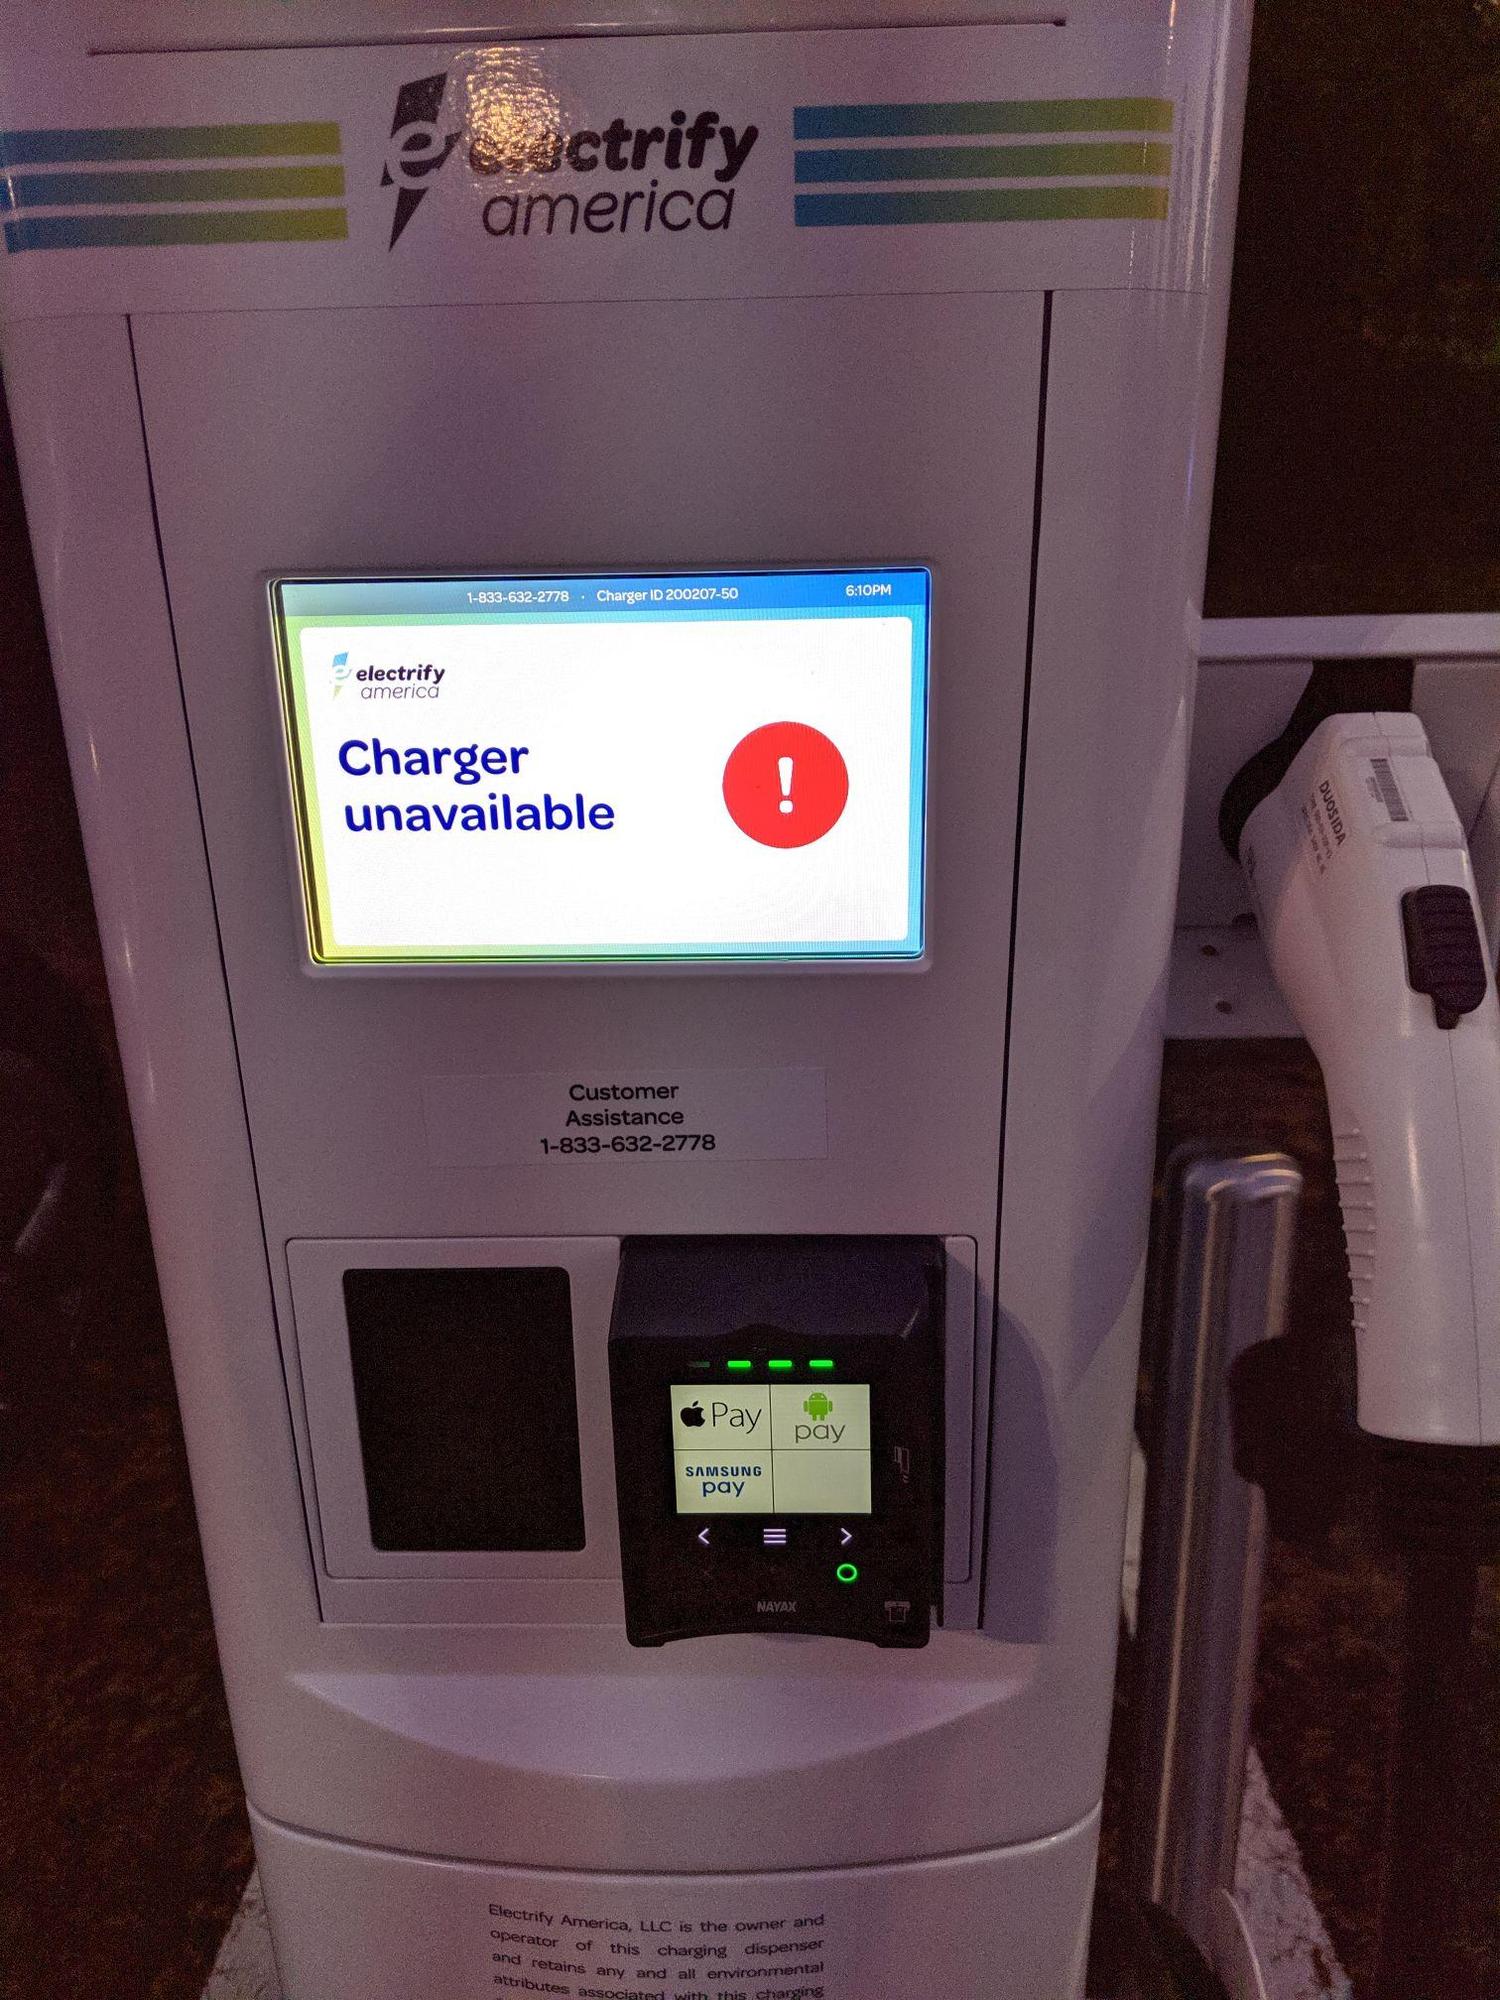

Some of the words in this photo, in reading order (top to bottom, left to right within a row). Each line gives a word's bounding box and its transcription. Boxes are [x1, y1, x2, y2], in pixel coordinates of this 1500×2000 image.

[469, 110, 759, 183] eectrify
[482, 179, 736, 237] america
[467, 590, 570, 605] 1-833-632-2778
[596, 588, 648, 605] Charger
[650, 589, 664, 602] ID
[665, 587, 739, 601] 200207-50
[845, 584, 892, 597] 6:10PM
[356, 664, 445, 684] electrify
[360, 683, 440, 700] america
[338, 737, 530, 786] Charger
[344, 792, 615, 832] unavailable
[1319, 780, 1346, 845] DUOSIDA
[569, 1084, 679, 1101] Customer
[565, 1109, 684, 1127] Assistance
[540, 1134, 716, 1154] 1-833-632-2778
[711, 1401, 763, 1435] Pay
[795, 1423, 846, 1443] pay
[685, 1465, 762, 1477] SAMSUNG
[702, 1479, 745, 1498] pay
[757, 1601, 797, 1613] NAYAX
[488, 1903, 553, 1927] Electrify
[561, 1914, 632, 1932] America,
[640, 1920, 672, 1932] LLC
[679, 1920, 693, 1933] is
[700, 1920, 728, 1932] the
[735, 1918, 786, 1932] owner
[793, 1913, 825, 1928] and
[489, 1929, 559, 1948] operator
[576, 1940, 594, 1951] of
[610, 1943, 640, 1955] this
[657, 1944, 727, 1959] charging
[744, 1939, 825, 1956] dispenser
[492, 1951, 522, 1966] and
[532, 1958, 586, 1974] retains
[596, 1965, 625, 1979] any
[636, 1968, 667, 1979] and
[678, 1968, 696, 1980] all
[707, 1961, 824, 1979] environmental
[494, 1974, 570, 1995] attributes
[578, 1987, 665, 2000] associated
[717, 1990, 747, 2000] this
[756, 1985, 825, 2000] charging
